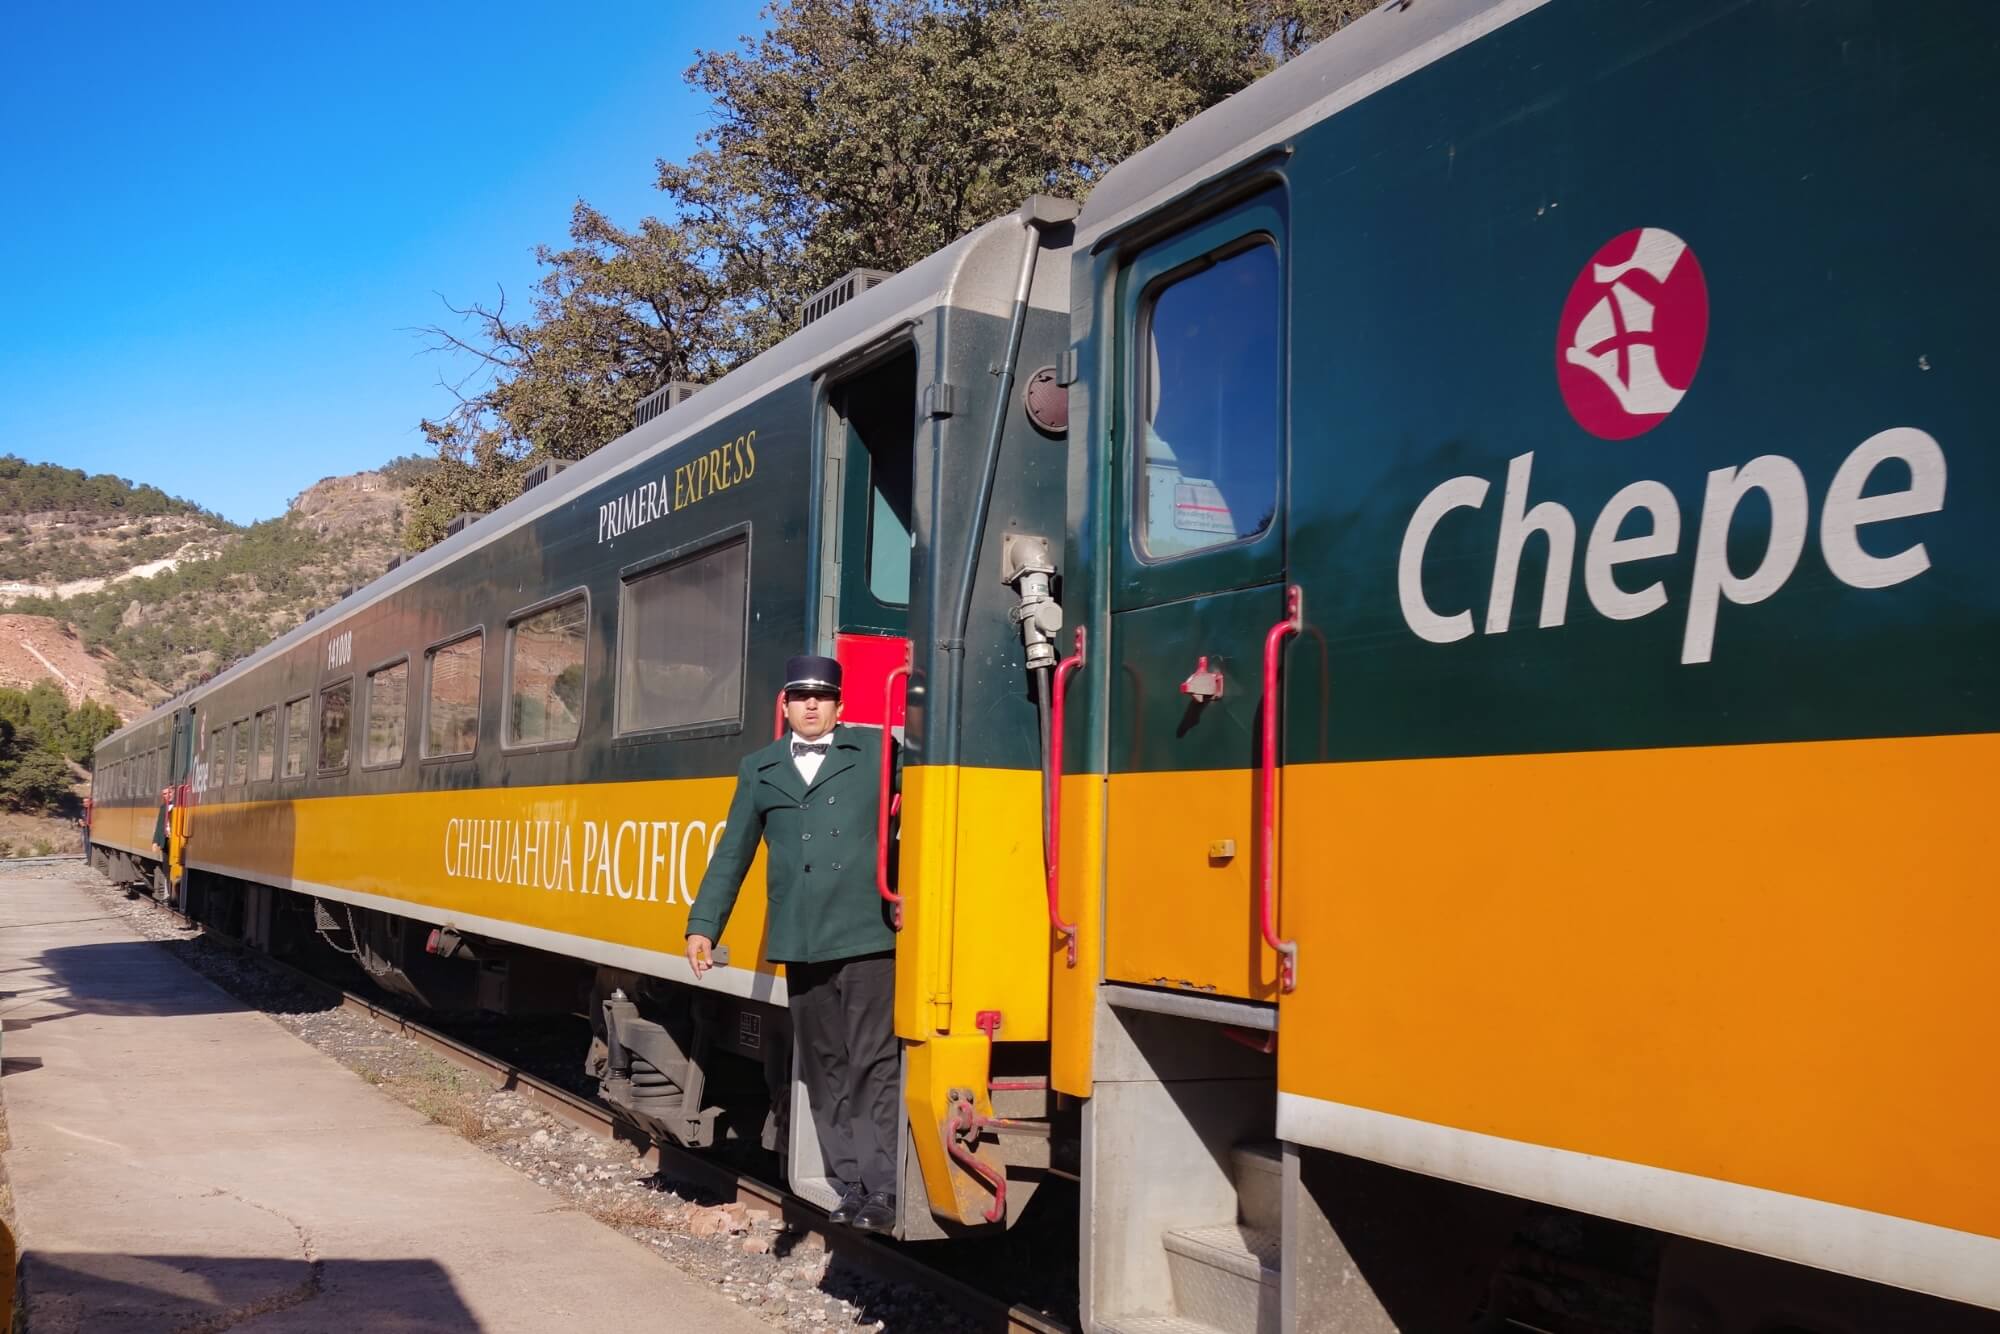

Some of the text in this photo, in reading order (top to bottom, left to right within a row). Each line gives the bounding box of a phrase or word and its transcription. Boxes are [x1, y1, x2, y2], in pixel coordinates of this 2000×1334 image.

[597, 430, 756, 543] PRIMERA EXPRESS
[444, 817, 574, 892] CHIHUAHUA
